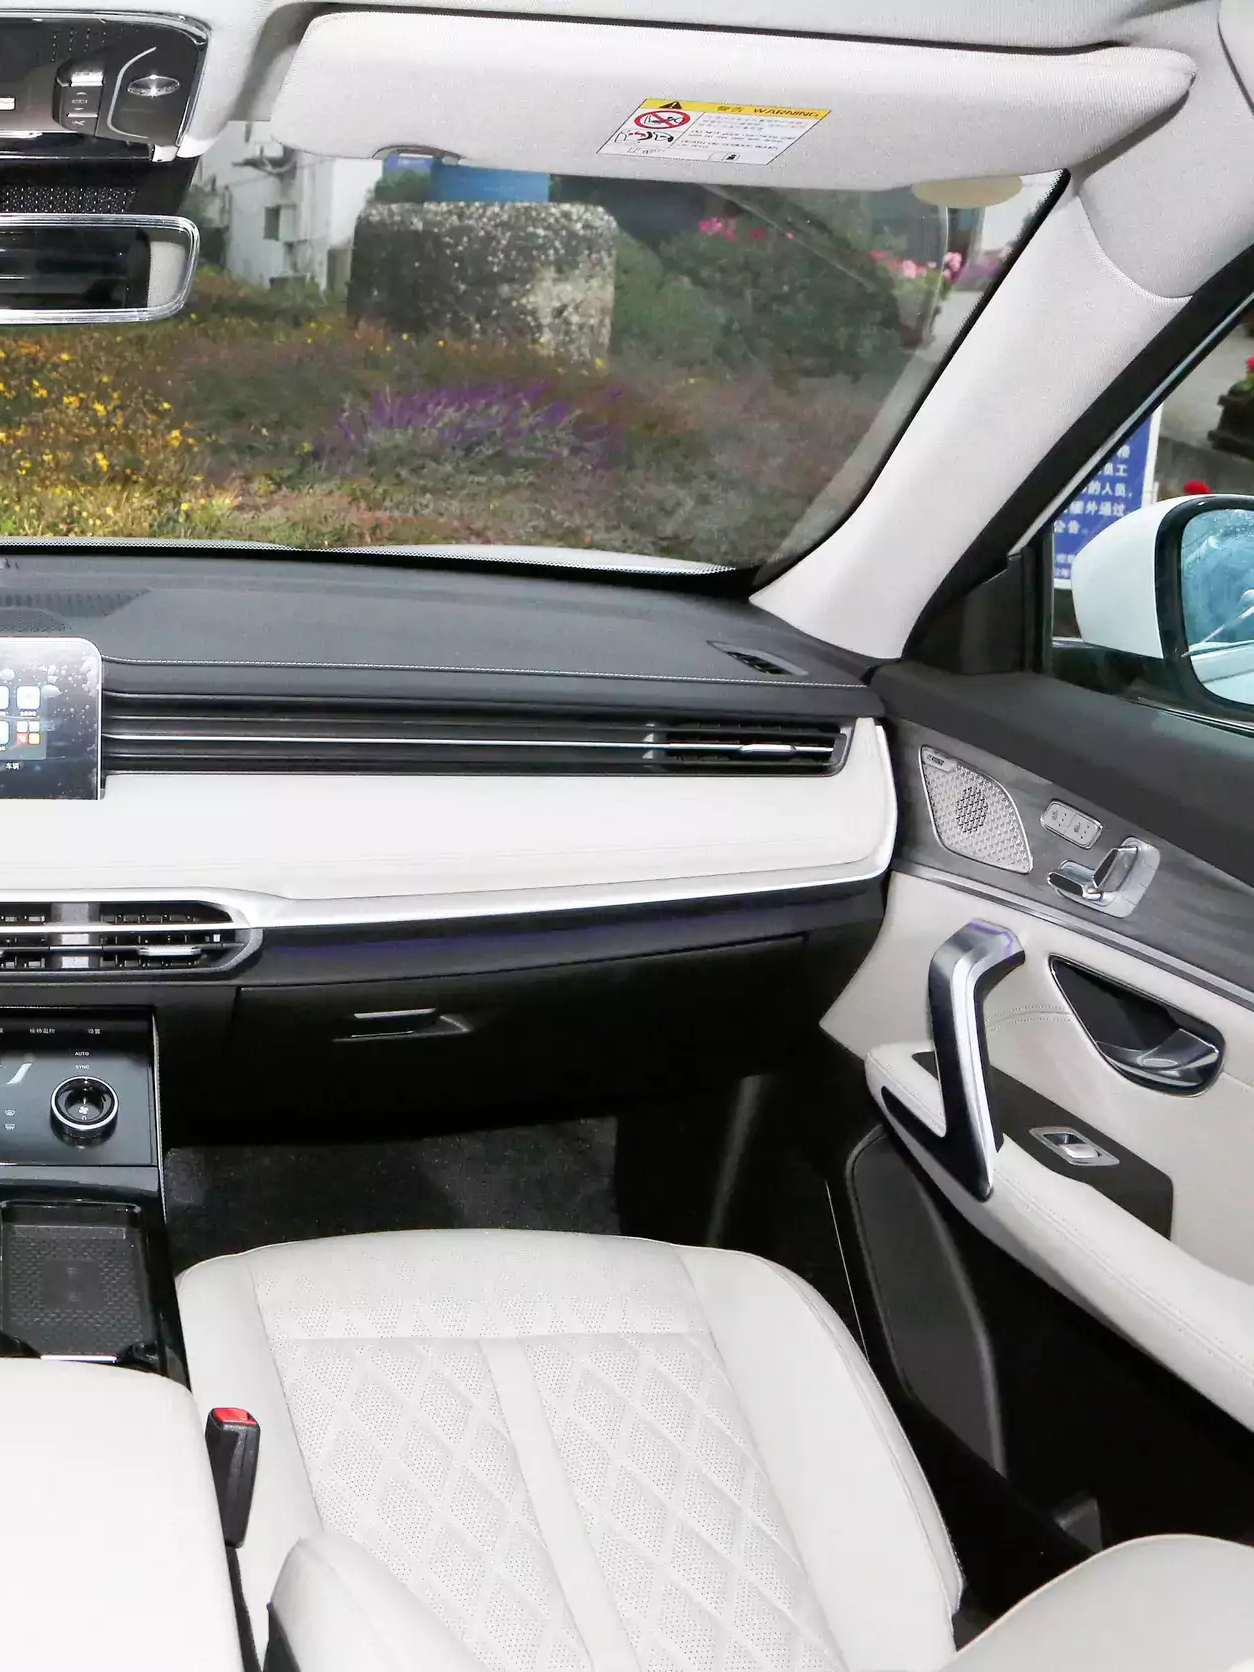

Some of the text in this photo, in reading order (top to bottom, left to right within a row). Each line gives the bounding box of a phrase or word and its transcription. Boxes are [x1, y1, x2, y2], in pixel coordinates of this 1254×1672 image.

[753, 108, 819, 118] WARNING
[1081, 480, 1133, 498] 的人员，
[6, 762, 20, 770] 车辆
